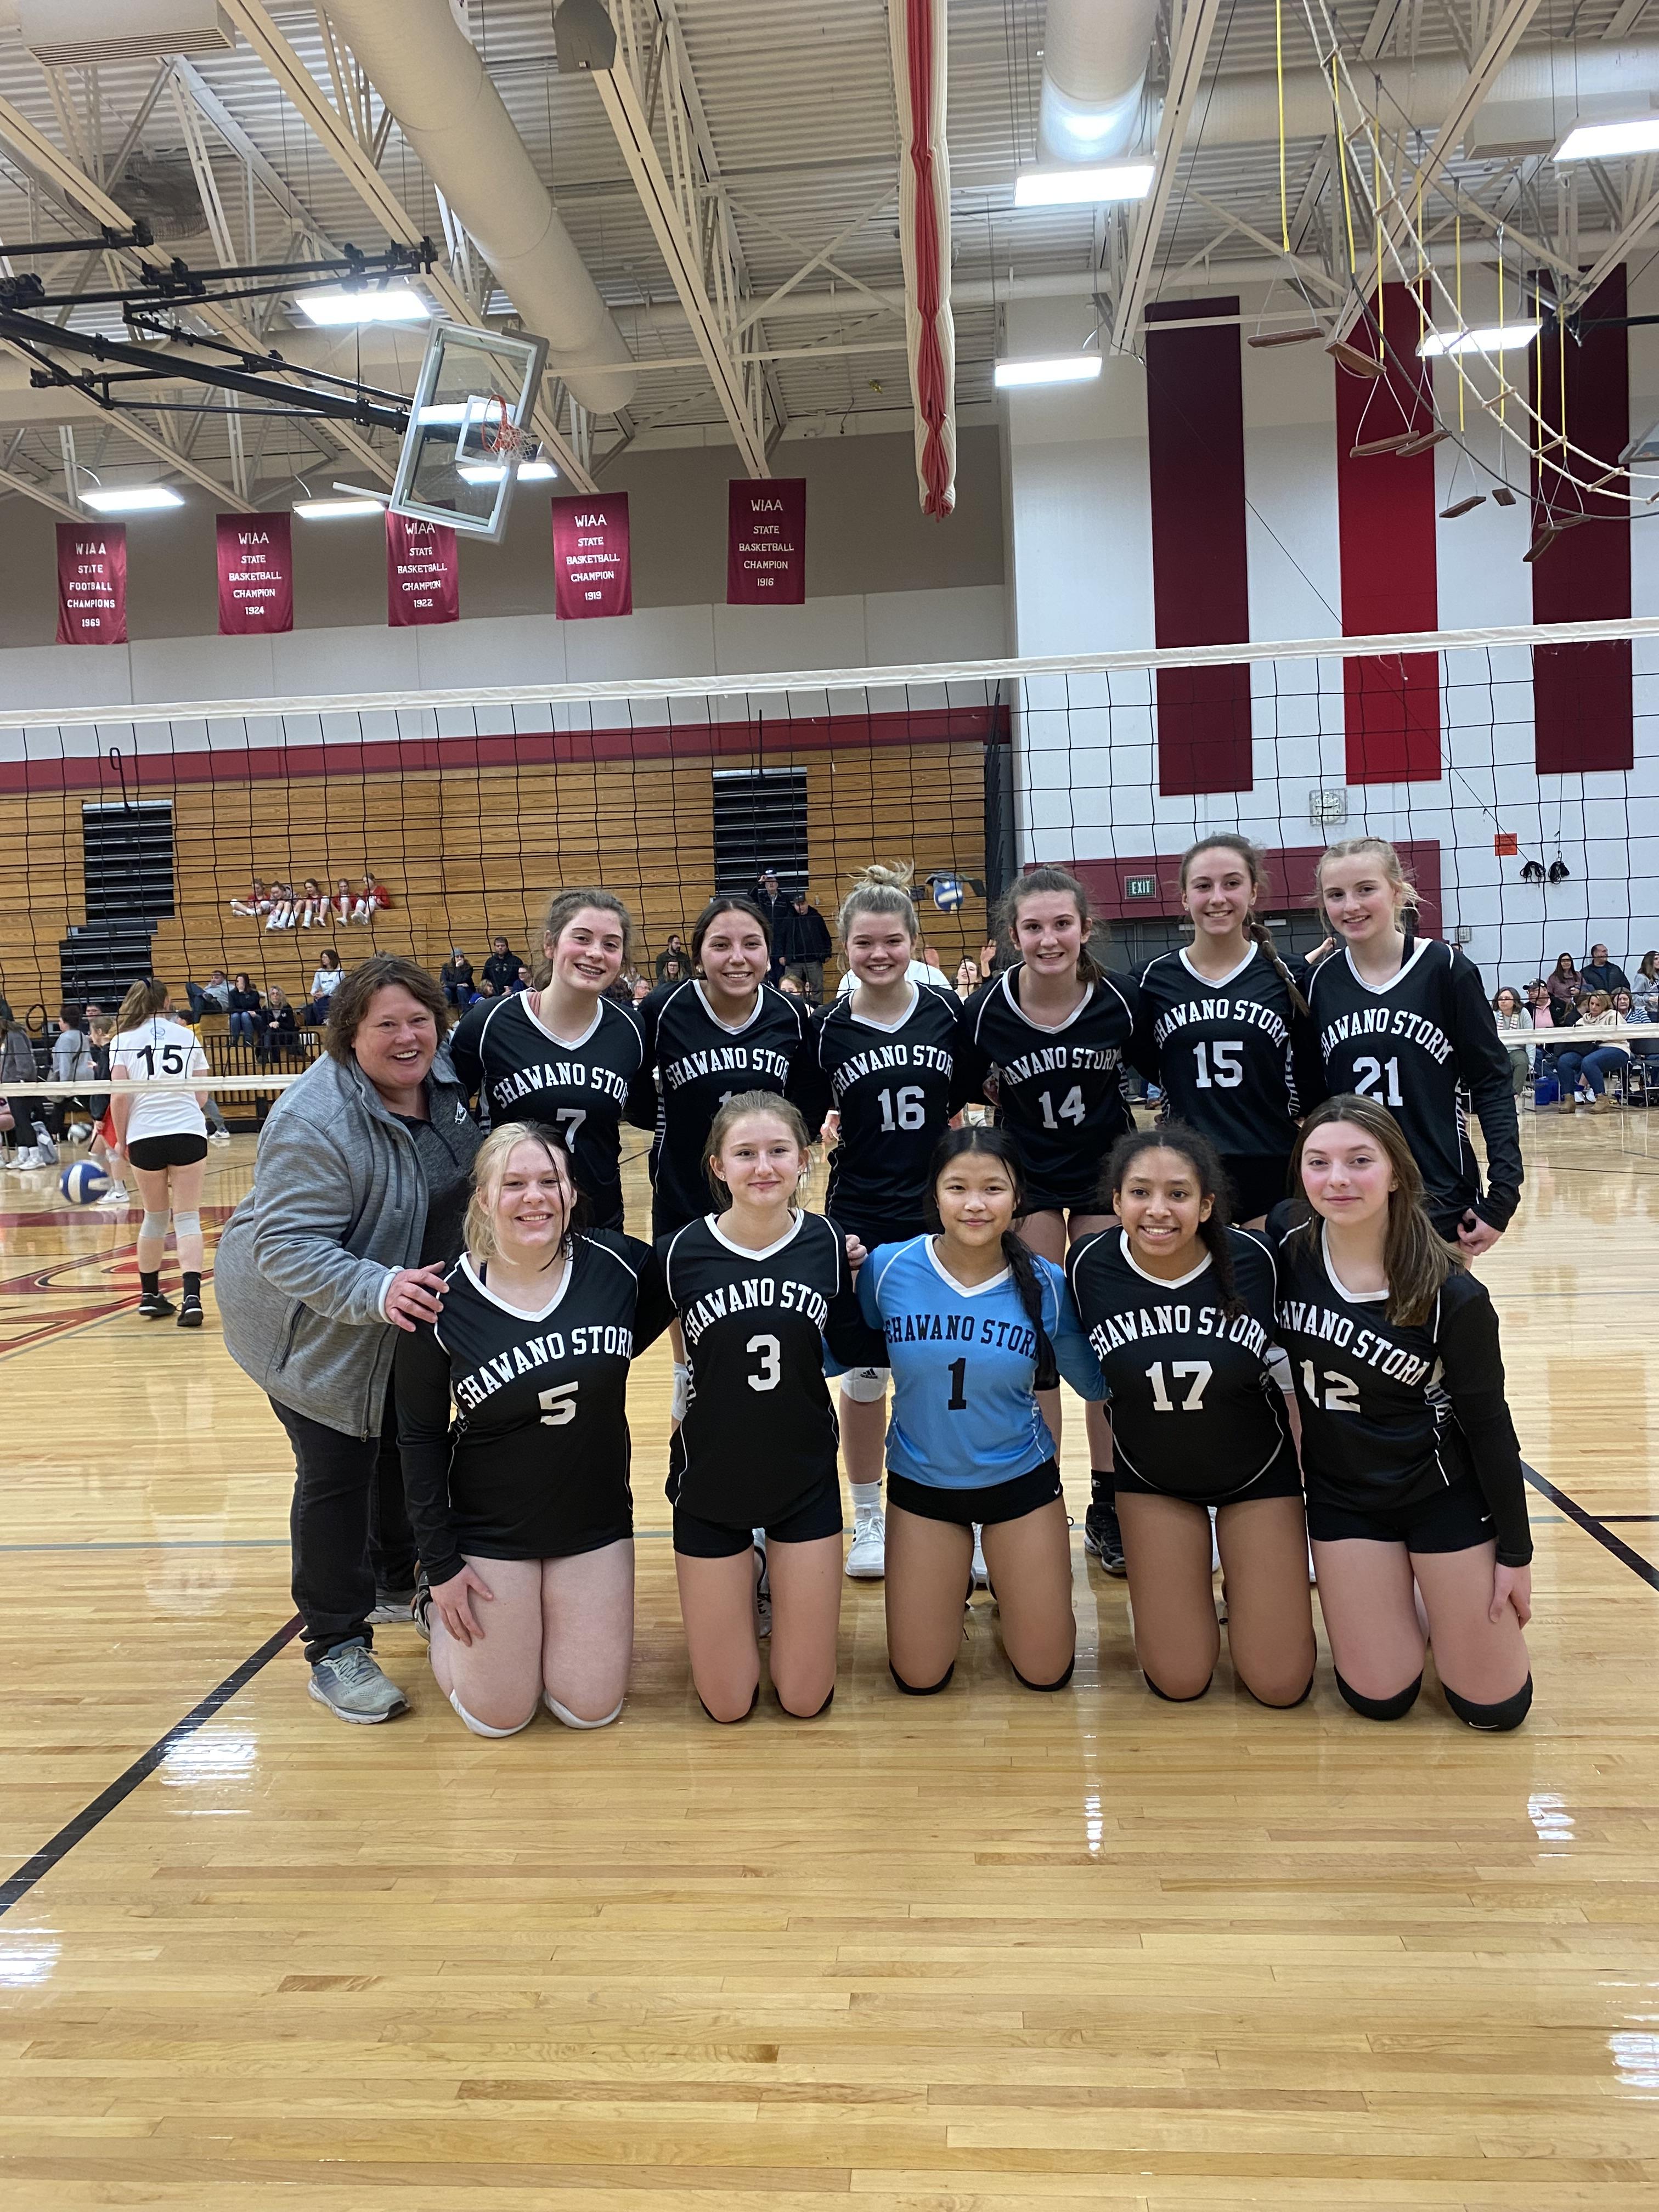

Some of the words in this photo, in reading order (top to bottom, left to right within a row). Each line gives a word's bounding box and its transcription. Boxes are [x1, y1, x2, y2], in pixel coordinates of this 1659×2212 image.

[751, 499, 783, 511] WIAA
[574, 514, 607, 527] WIAA
[405, 522, 435, 535] WIAA
[753, 525, 780, 534] STATE
[238, 532, 269, 545] WIAA
[578, 537, 604, 547] STATE
[76, 543, 106, 555] WIAA
[409, 546, 432, 556] STATE
[739, 543, 794, 552] BASKETBALL
[241, 555, 266, 564] STATE
[566, 553, 620, 565] BASKETBALL
[743, 560, 788, 569] CHAMPION
[78, 564, 103, 573] STATE
[397, 563, 448, 574] BASKETBALL
[229, 571, 282, 581] BASKETBALL
[571, 571, 614, 582] CHAMPION
[757, 578, 774, 586] 1916
[69, 582, 112, 591] FOOTBALL
[402, 580, 441, 591] CHAMPION
[233, 588, 275, 598] CHAMPION
[585, 591, 602, 601] 1919
[67, 599, 115, 608] CHAMPIONS
[413, 599, 433, 608] 1922
[245, 606, 264, 615] 1924
[82, 618, 100, 627] 1969
[1132, 881, 1150, 894] EXIT
[1154, 998, 1229, 1050] SHAWANO
[1391, 1010, 1454, 1065] STORM
[137, 1044, 183, 1076] 15
[1001, 1046, 1066, 1086] HAWANO
[1193, 1041, 1243, 1088] 15
[665, 1047, 747, 1090] SHAWANO
[752, 1048, 789, 1083] STOR
[832, 1044, 907, 1097] SHAWANO
[913, 1045, 953, 1077] STOR
[493, 1062, 585, 1109] SHAWANO
[590, 1066, 629, 1107] STOR
[1352, 1057, 1403, 1107] 21
[878, 1086, 926, 1132] 16
[1039, 1085, 1086, 1129] 14
[556, 1108, 586, 1153] 7
[686, 1278, 775, 1345] SHAWANO
[780, 1280, 828, 1330] STOR
[885, 1314, 975, 1344] SHAWANO
[980, 1319, 1037, 1361] STOR
[1089, 1305, 1191, 1362] SHAWANO
[1197, 1307, 1267, 1358] STORM
[747, 1334, 781, 1391] 3
[1352, 1329, 1430, 1386] STORM
[457, 1333, 566, 1409] SHAWANO
[948, 1357, 967, 1410] 1
[1145, 1361, 1213, 1411] 17
[1300, 1359, 1361, 1413] 12
[538, 1380, 579, 1425] 5
